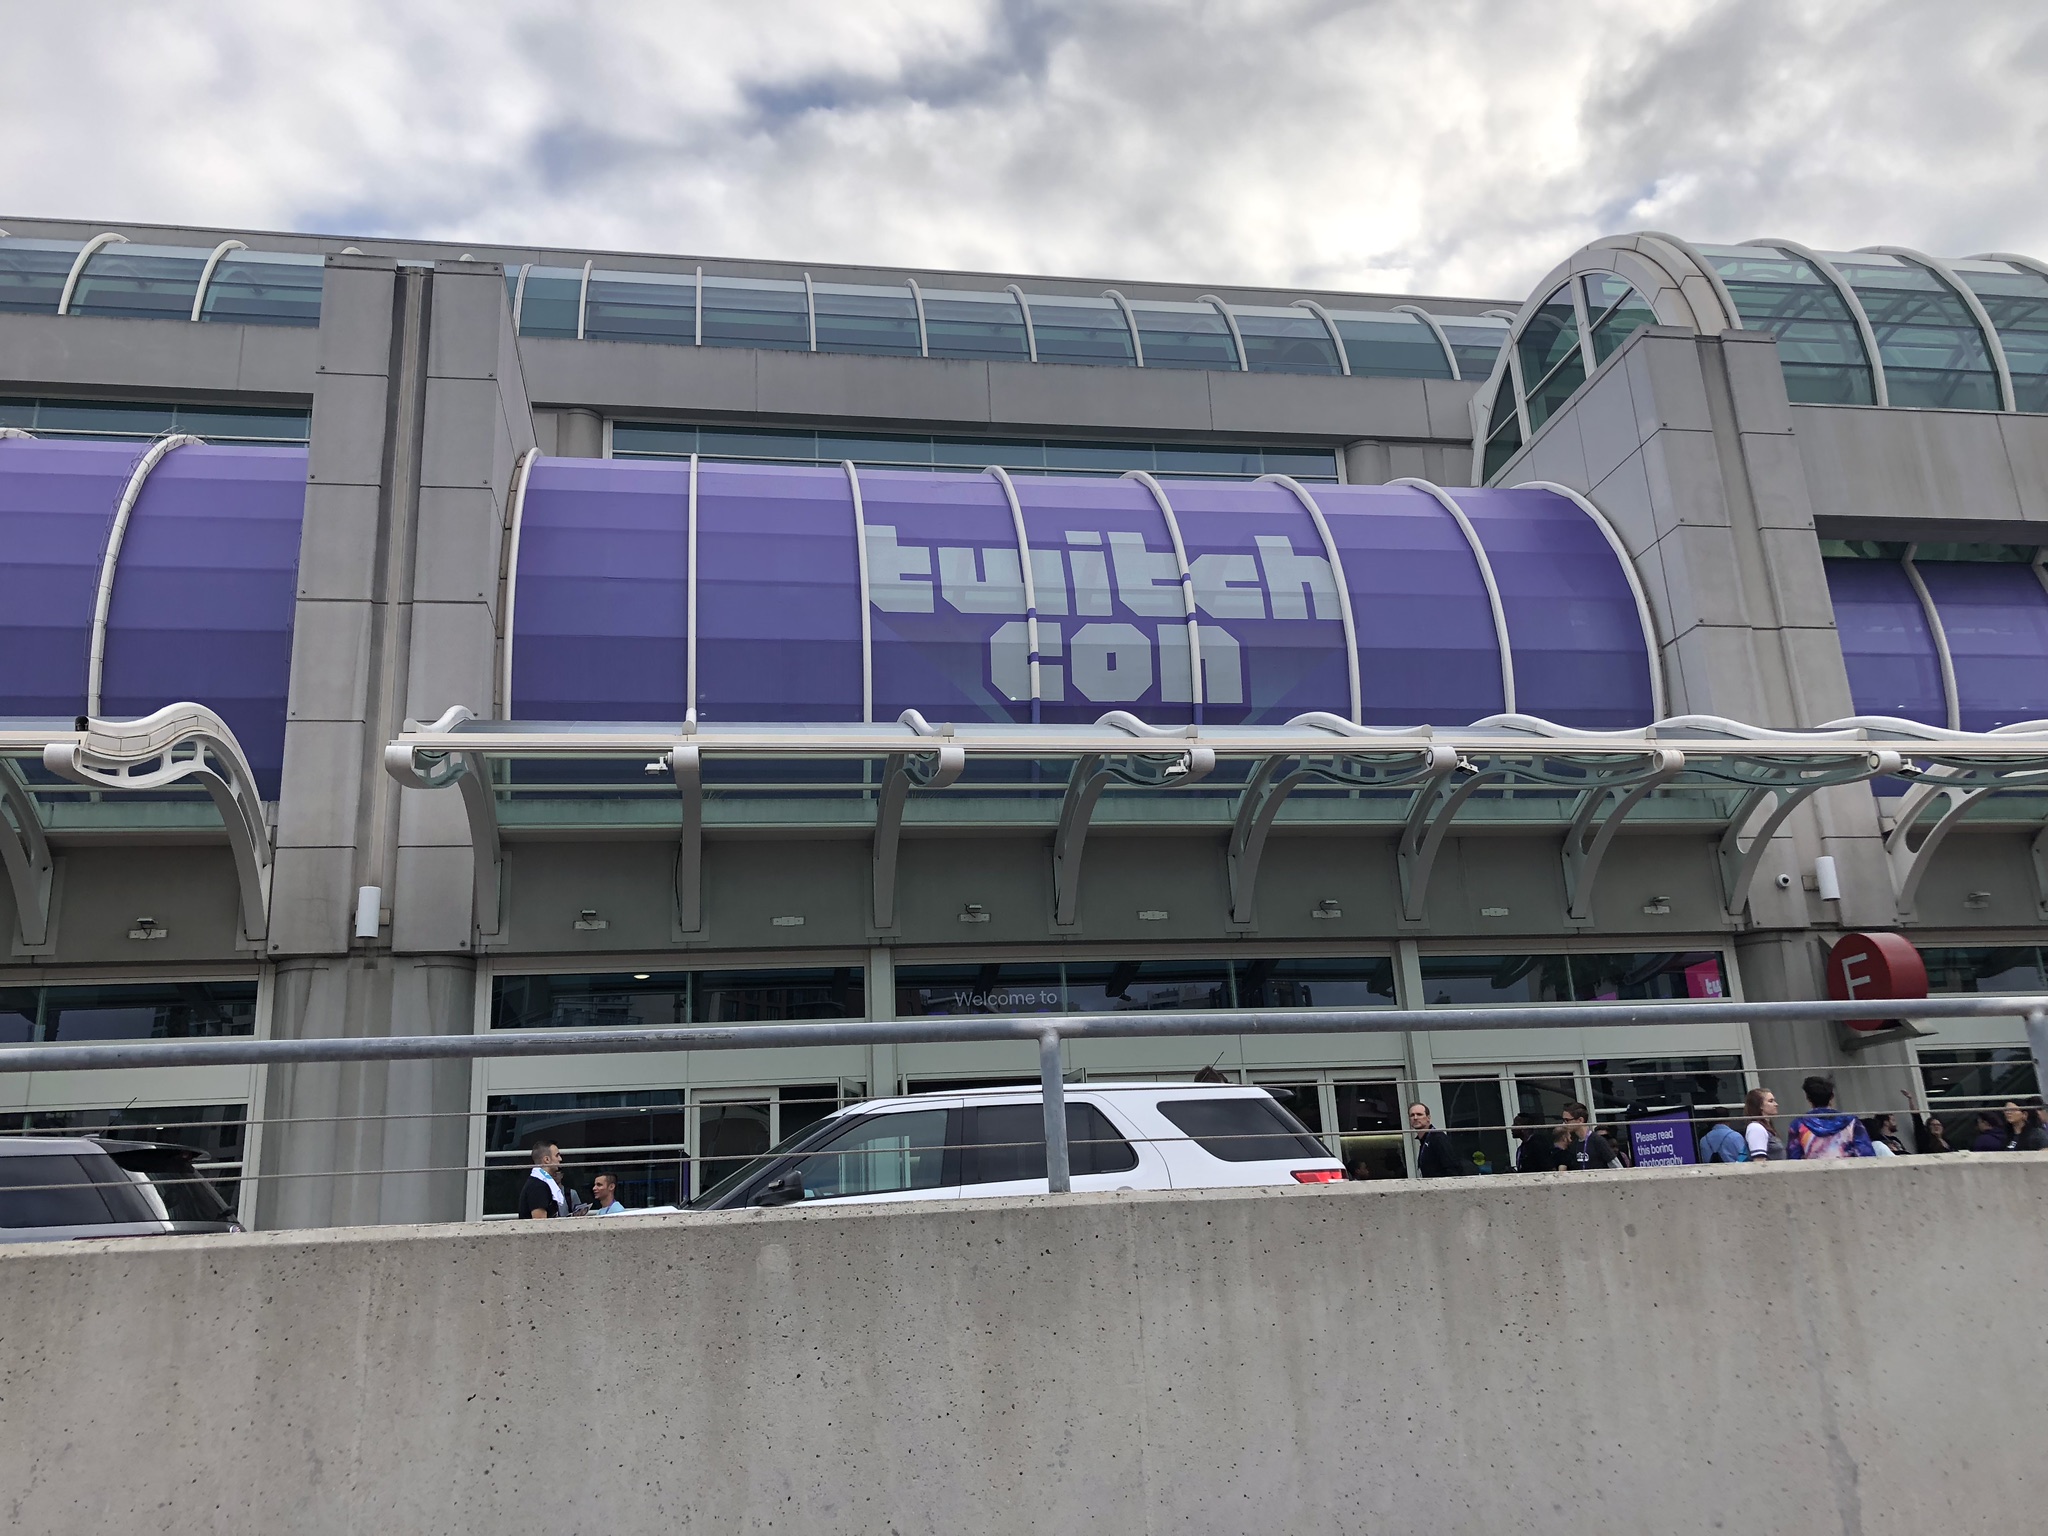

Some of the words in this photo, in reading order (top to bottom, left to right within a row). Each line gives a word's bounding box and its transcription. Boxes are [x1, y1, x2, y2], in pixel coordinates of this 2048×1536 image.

[864, 525, 1343, 620] twitch
[990, 621, 1243, 703] con
[954, 991, 1036, 1007] Welcome
[1039, 990, 1058, 1005] to
[1635, 1131, 1658, 1143] Please
[1657, 1127, 1674, 1140] read
[1637, 1144, 1650, 1155] this
[1650, 1142, 1674, 1155] boring
[1639, 1154, 1683, 1167] photography
